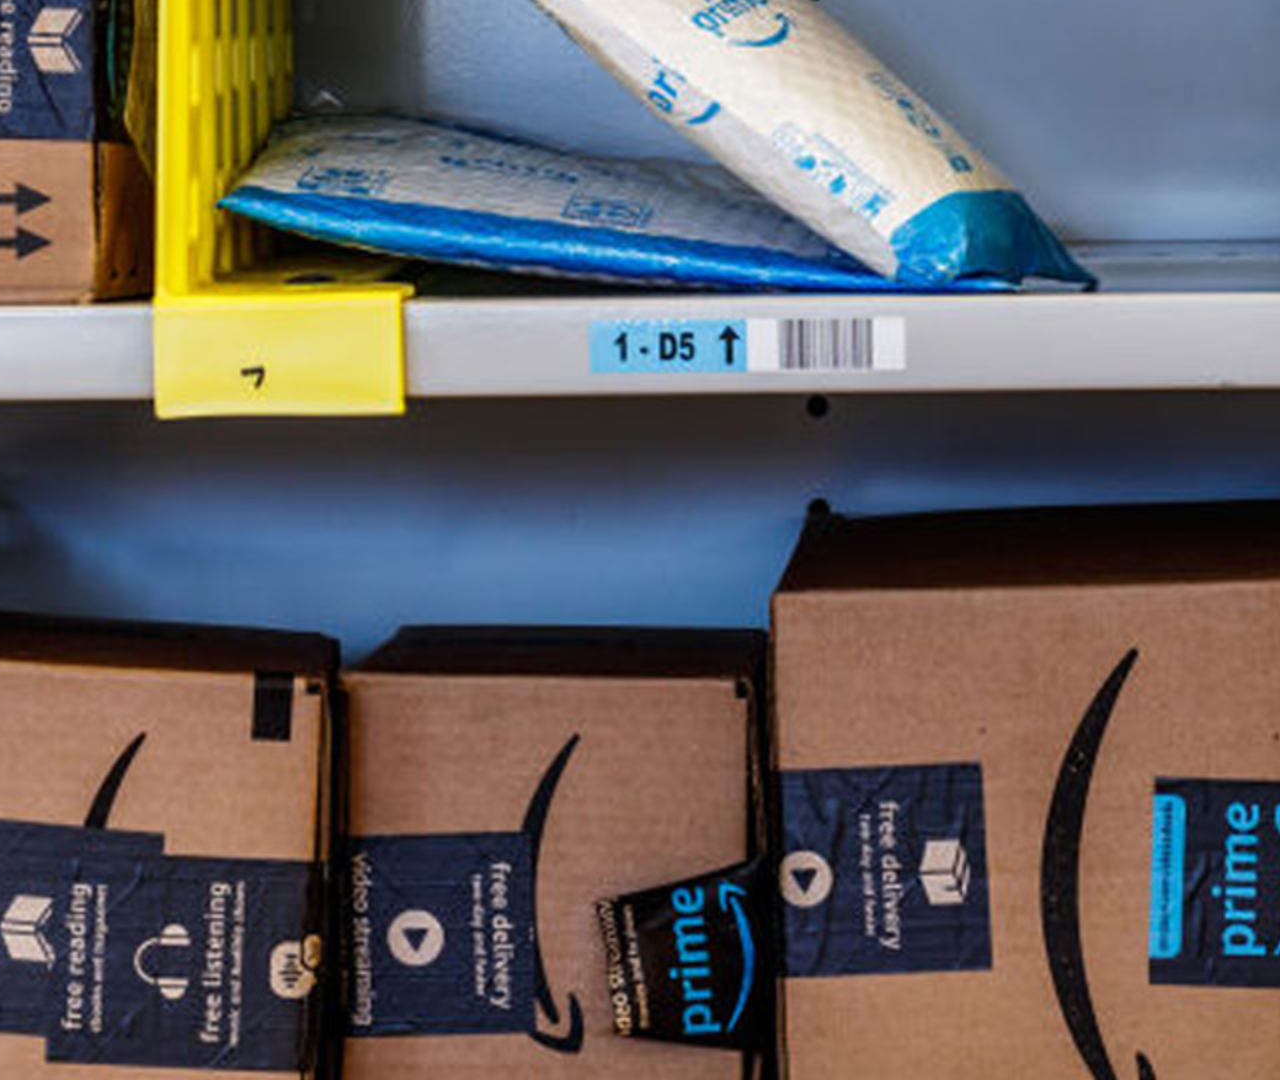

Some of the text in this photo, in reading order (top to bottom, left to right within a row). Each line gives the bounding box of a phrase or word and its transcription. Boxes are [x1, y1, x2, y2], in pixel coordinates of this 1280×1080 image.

[660, 332, 695, 362] D5
[352, 852, 373, 1026] video streaming
[489, 861, 513, 1009] free delivery
[879, 801, 902, 949] free delivery
[1212, 802, 1265, 957] prime
[61, 883, 92, 1030] free reading
[199, 882, 231, 1043] free listening
[670, 886, 720, 1036] prime
